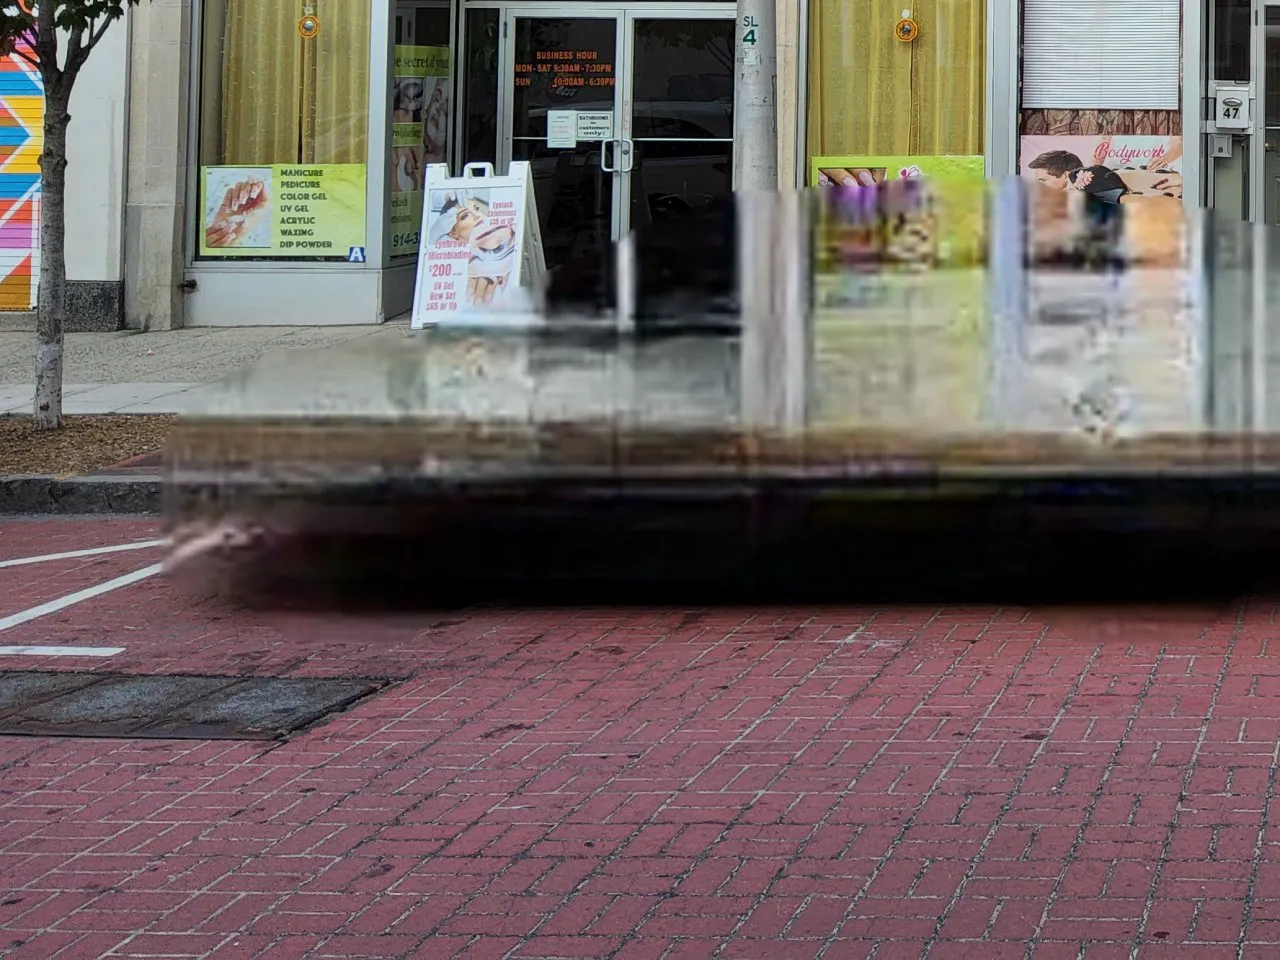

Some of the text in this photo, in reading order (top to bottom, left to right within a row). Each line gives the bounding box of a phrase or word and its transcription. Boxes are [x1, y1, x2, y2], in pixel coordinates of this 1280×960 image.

[743, 15, 759, 27] SL
[742, 29, 757, 45] 4
[536, 51, 598, 59] BUSINESS HOUR
[515, 78, 531, 86] SUN
[1223, 107, 1240, 119] 47
[1094, 141, 1167, 165] Bodywork
[280, 169, 324, 177] MANICURE
[435, 240, 467, 249] Eyebrows
[428, 251, 472, 260] Microblading
[428, 264, 452, 277] $200
[440, 302, 448, 310] or
